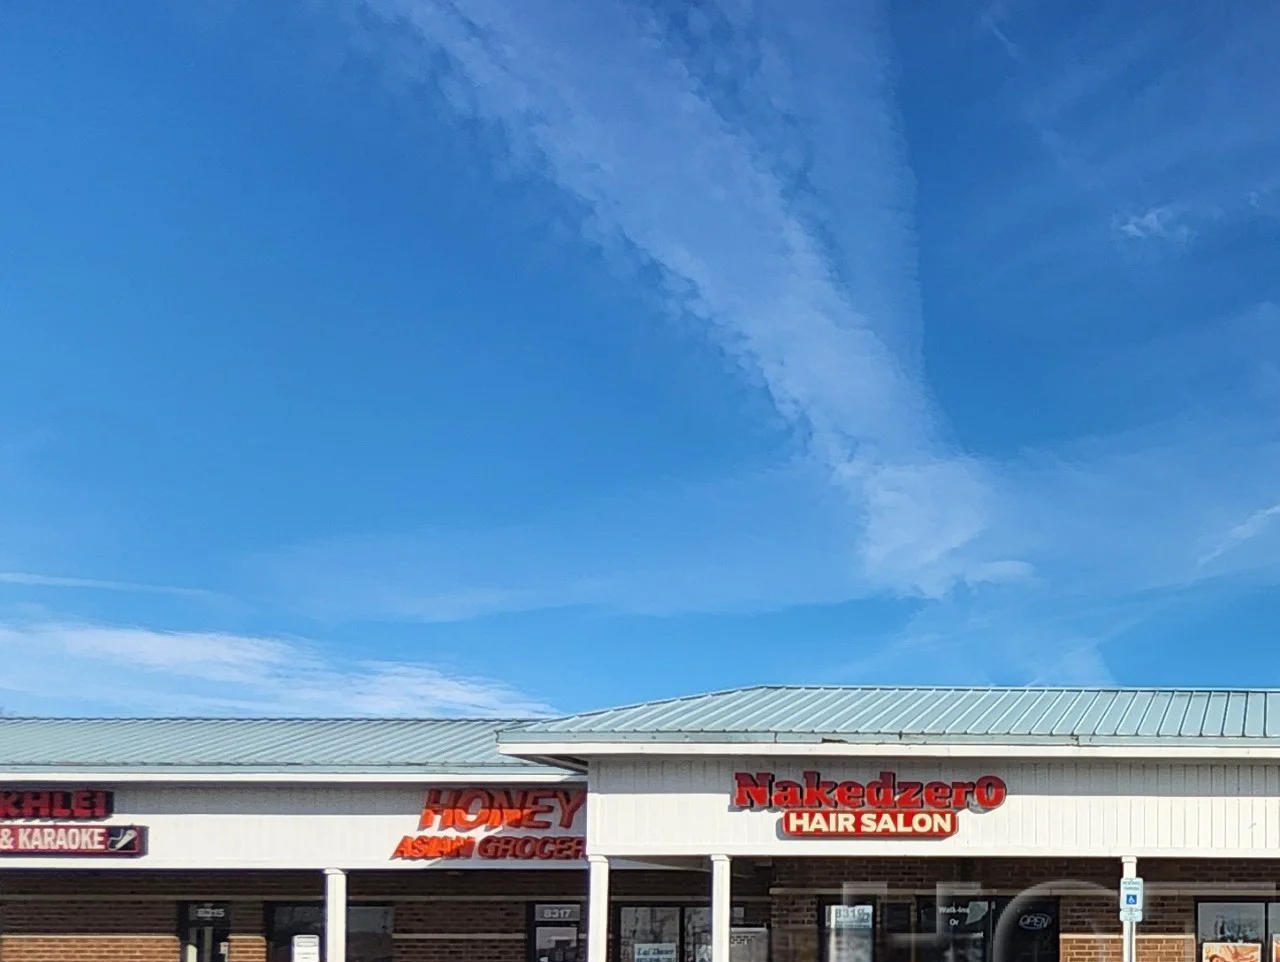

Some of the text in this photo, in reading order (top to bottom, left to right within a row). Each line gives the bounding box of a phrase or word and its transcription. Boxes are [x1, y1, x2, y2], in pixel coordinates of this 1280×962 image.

[419, 788, 586, 829] HONEY
[789, 813, 952, 833] HAIR SALON
[0, 828, 106, 849] & KARAOKE
[394, 835, 476, 859] ASIAN
[543, 908, 572, 919] 8317
[1020, 914, 1050, 929] OPEN
